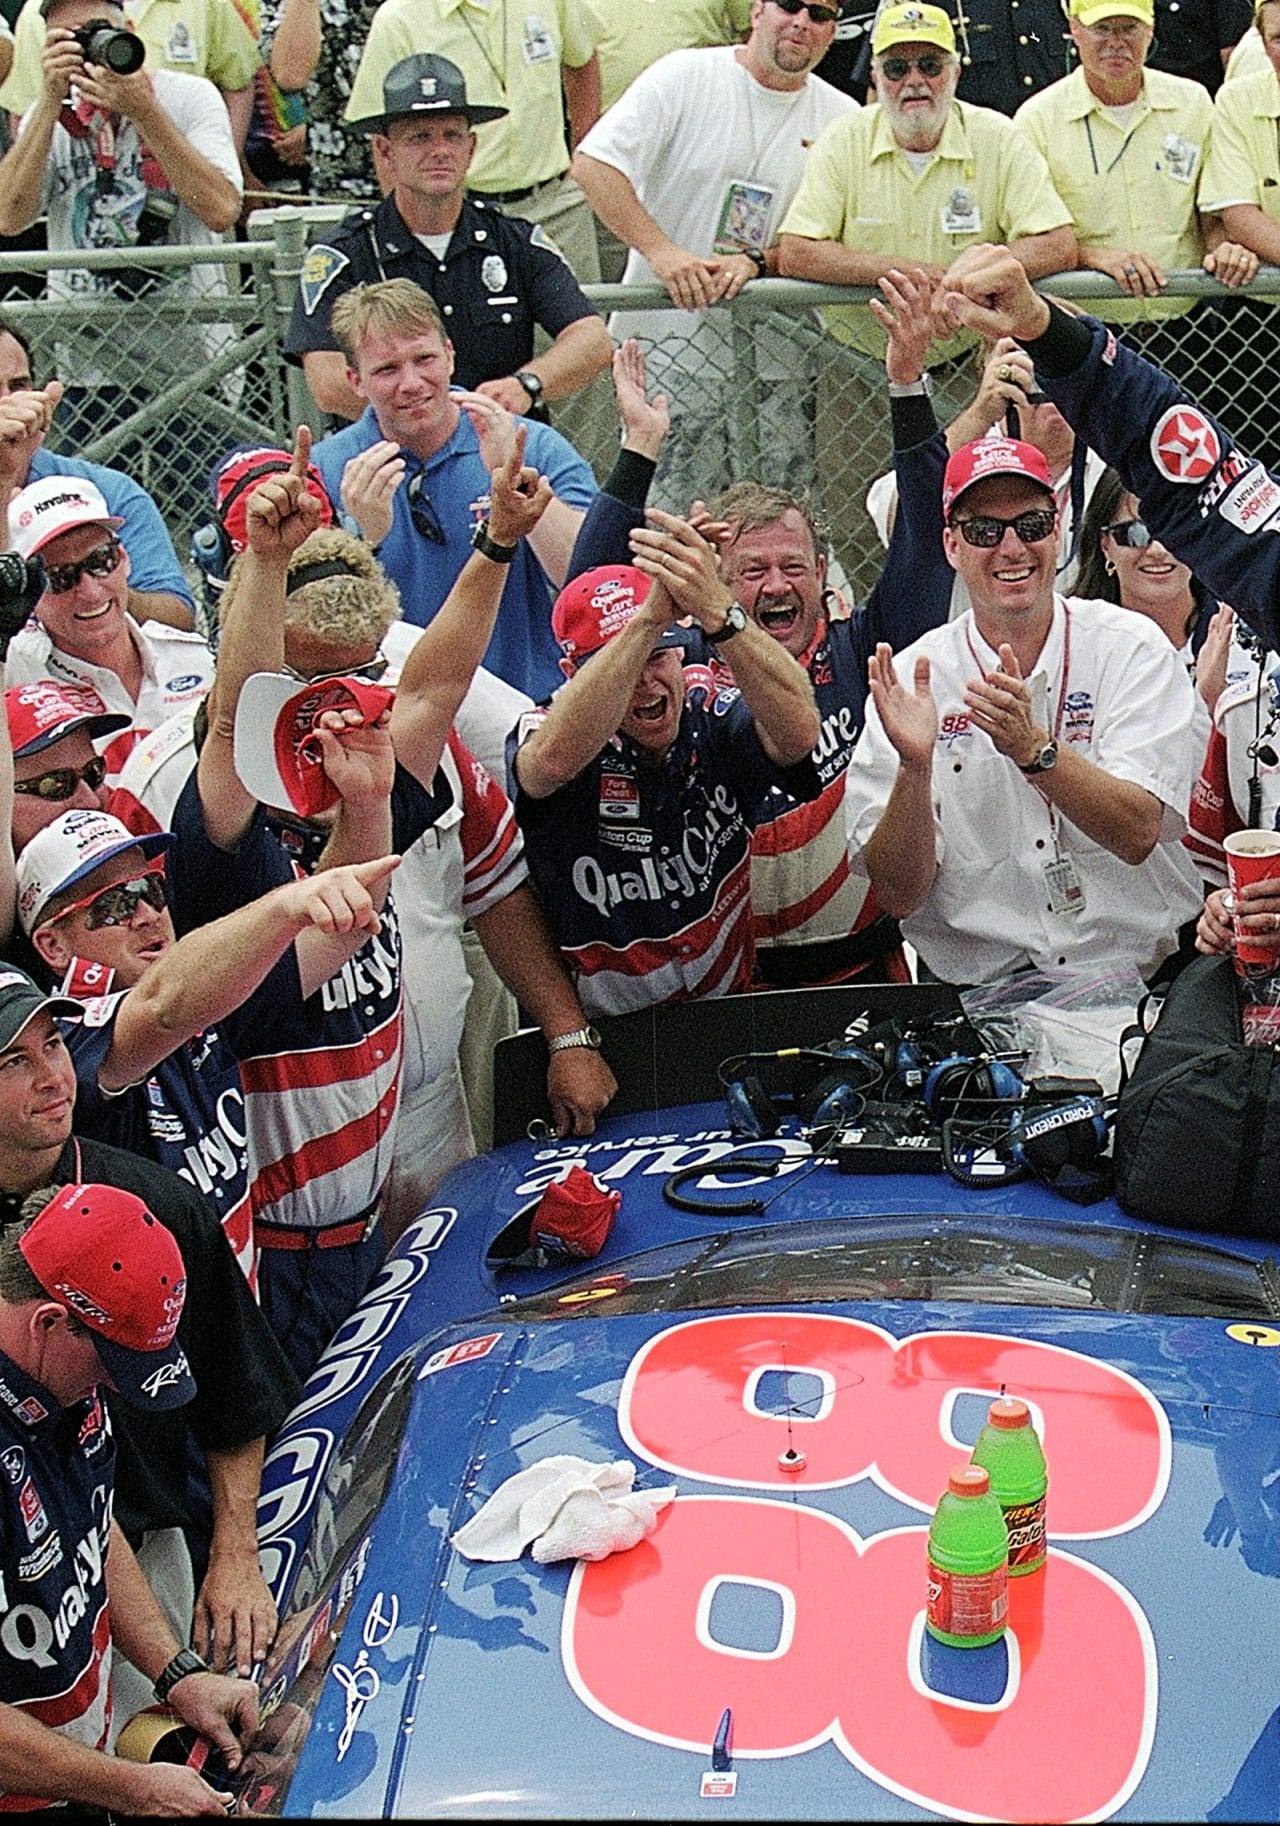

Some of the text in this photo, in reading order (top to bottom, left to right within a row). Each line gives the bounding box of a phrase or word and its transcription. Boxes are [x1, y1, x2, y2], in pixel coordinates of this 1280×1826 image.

[591, 587, 634, 608] Quality
[598, 605, 641, 629] SERVIC
[940, 713, 971, 734] 88
[627, 832, 653, 845] Cup
[1024, 1104, 1095, 1140] FORD CREDIT
[1007, 1521, 1046, 1548] Gato
[561, 1312, 1173, 1824] 88
